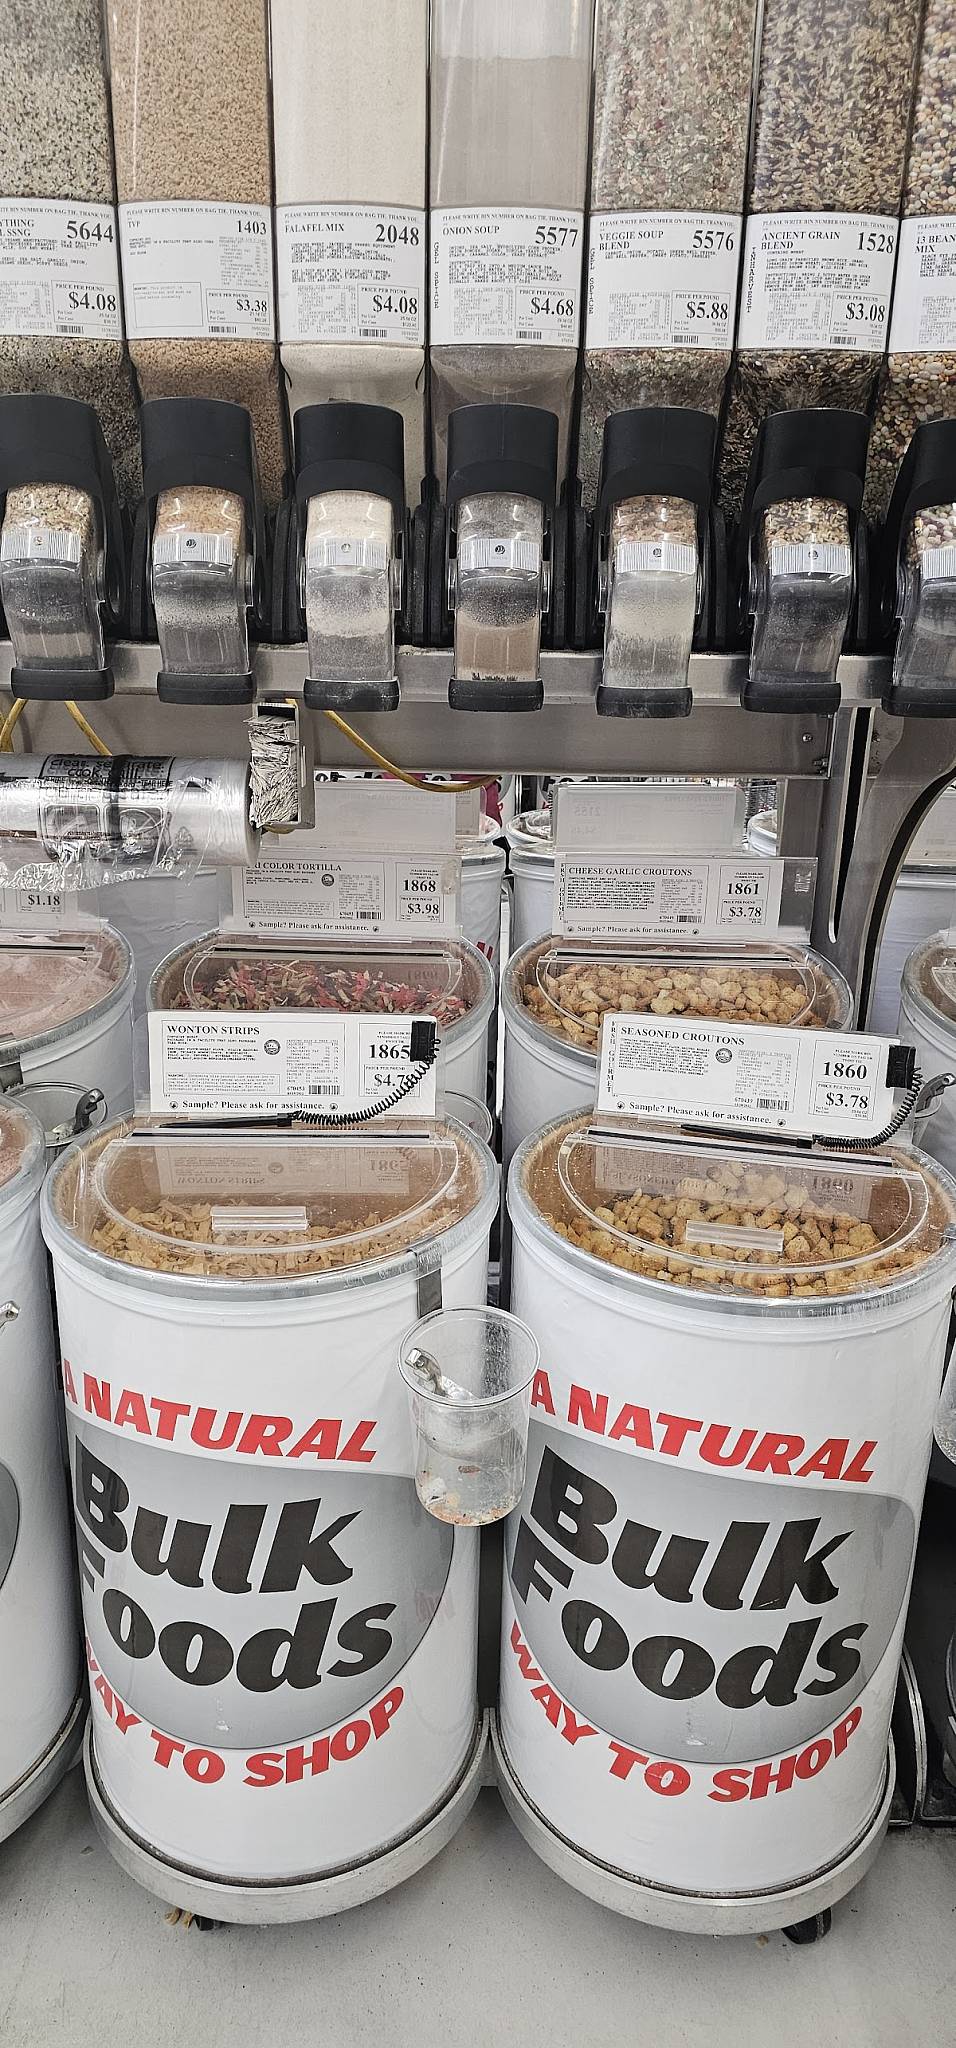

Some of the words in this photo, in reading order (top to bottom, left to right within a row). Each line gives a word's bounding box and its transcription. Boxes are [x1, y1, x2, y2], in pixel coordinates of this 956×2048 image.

[0, 219, 34, 228] YTHING
[237, 220, 266, 234] 1403
[285, 224, 324, 233] FALAFEL
[67, 220, 113, 242] 5644
[376, 224, 419, 246] 2048
[443, 227, 472, 236] ONION
[475, 226, 500, 234] SOUP
[535, 226, 578, 247] 5577
[600, 232, 635, 240] VEGGIE
[638, 231, 663, 239] SOUP
[762, 232, 806, 241] ANCIENT
[808, 232, 840, 240] GRAIN
[600, 241, 629, 250] BLEND
[693, 230, 734, 251] 5576
[761, 241, 793, 250] BLEND
[857, 232, 894, 254] 1528
[917, 236, 926, 244] 13
[928, 234, 956, 243] BEAN
[915, 245, 935, 253] MIX
[69, 292, 116, 311] $4.08
[237, 300, 267, 312] $3.38
[373, 295, 417, 314] $4.08
[531, 297, 574, 316] $4.68
[687, 302, 728, 320] $5.88
[846, 303, 885, 322] $3.08
[97, 760, 164, 769] serate.
[298, 863, 342, 871] TORTILLA
[569, 868, 603, 876] CHEESE
[606, 868, 641, 876] GARLIC
[643, 868, 692, 876] CROUTONS
[403, 880, 436, 893] 1868
[727, 882, 759, 895] 1861
[28, 894, 60, 906] $1.18
[407, 903, 439, 915] $3.98
[729, 906, 762, 919] $3.78
[259, 921, 286, 929] Sample?
[288, 922, 309, 930] Please
[333, 923, 369, 931] assistance.
[578, 926, 606, 934] Sample?
[167, 1025, 218, 1034] WONTON
[220, 1026, 260, 1035] STRIPS
[621, 1027, 679, 1040] SEASONED
[682, 1032, 745, 1046] CROUTONS
[368, 1045, 410, 1060] 1865
[823, 1061, 867, 1080] 1860
[182, 1100, 218, 1110] Sample?
[221, 1101, 248, 1110] Please
[250, 1101, 263, 1110] ask
[265, 1101, 278, 1110] for
[280, 1102, 325, 1111] assistance.
[825, 1091, 869, 1109] $3.78
[629, 1102, 664, 1113] Sample?
[666, 1105, 692, 1115] Please
[695, 1108, 709, 1117] ask
[711, 1109, 725, 1120] for
[726, 1112, 772, 1124] assistance.
[63, 1359, 78, 1403] A
[83, 1372, 377, 1463] NATURAL
[530, 1367, 556, 1416] A
[567, 1383, 878, 1482] NATURAL
[74, 1434, 363, 1594] Bulk
[530, 1445, 855, 1611] Bulk
[76, 1518, 397, 1693] Foods
[510, 1515, 869, 1710] Foods
[510, 1619, 599, 1746] WAY
[607, 1740, 691, 1796] TO
[707, 1706, 863, 1802] SHOP
[150, 1729, 226, 1784] TO
[242, 1686, 404, 1788] SHOP
